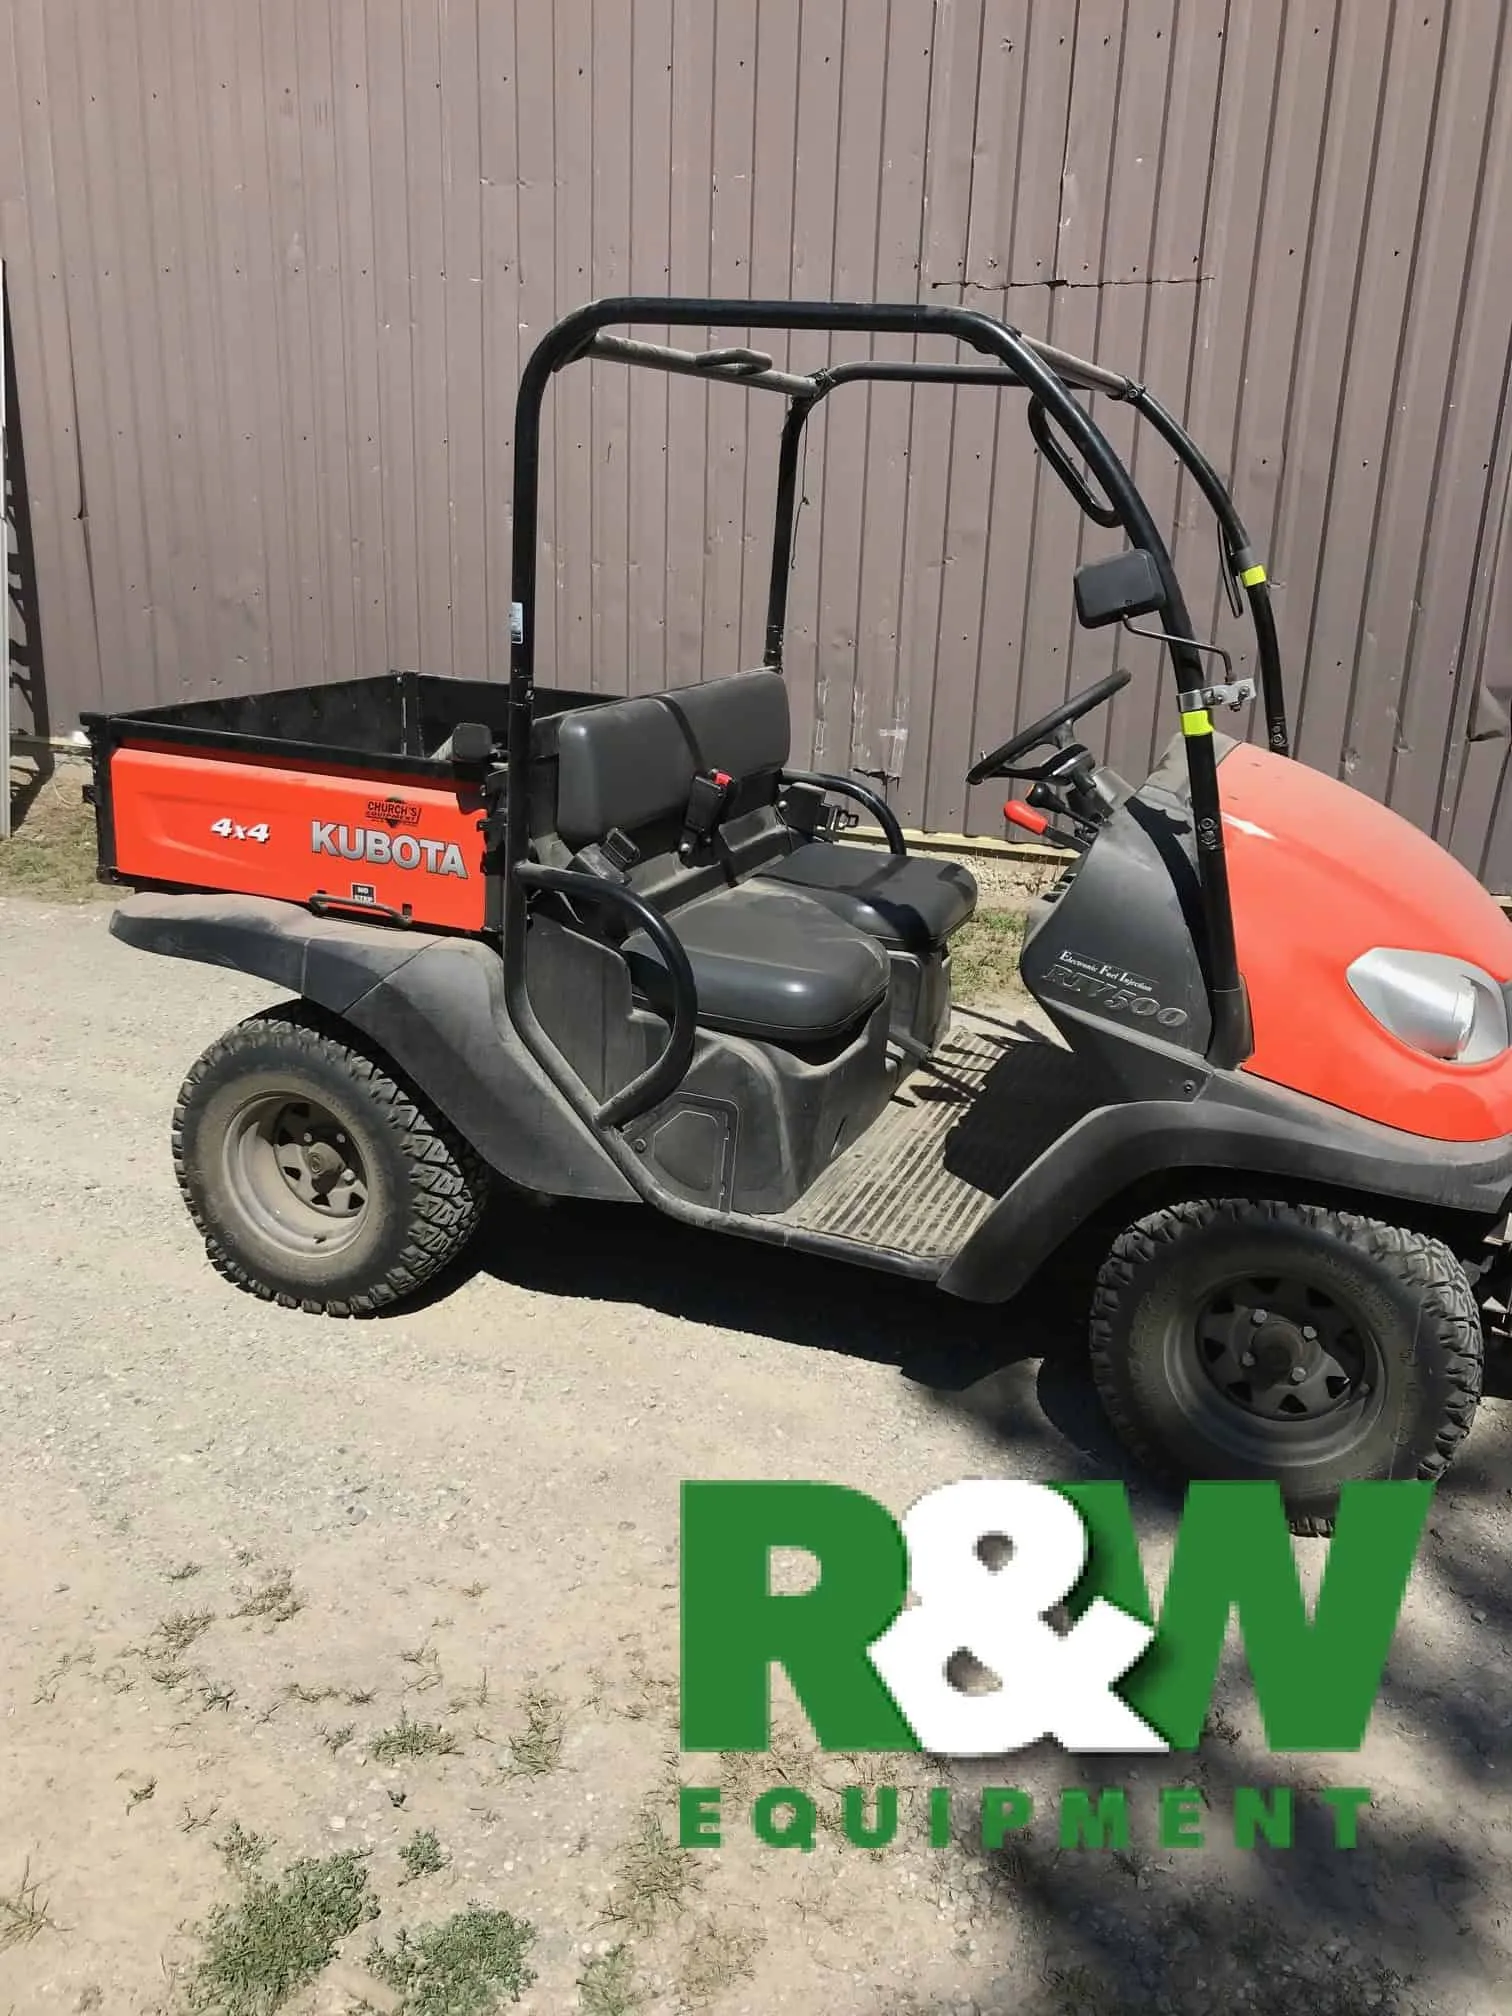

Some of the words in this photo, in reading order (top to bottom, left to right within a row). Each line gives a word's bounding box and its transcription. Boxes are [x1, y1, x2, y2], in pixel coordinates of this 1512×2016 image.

[367, 801, 418, 817] CHURCH'S
[211, 818, 270, 844] 4x4
[311, 820, 468, 879] KUBOTA
[1060, 951, 1098, 973] Electronic
[1100, 965, 1119, 980] Fuel
[1120, 972, 1153, 992] Injection
